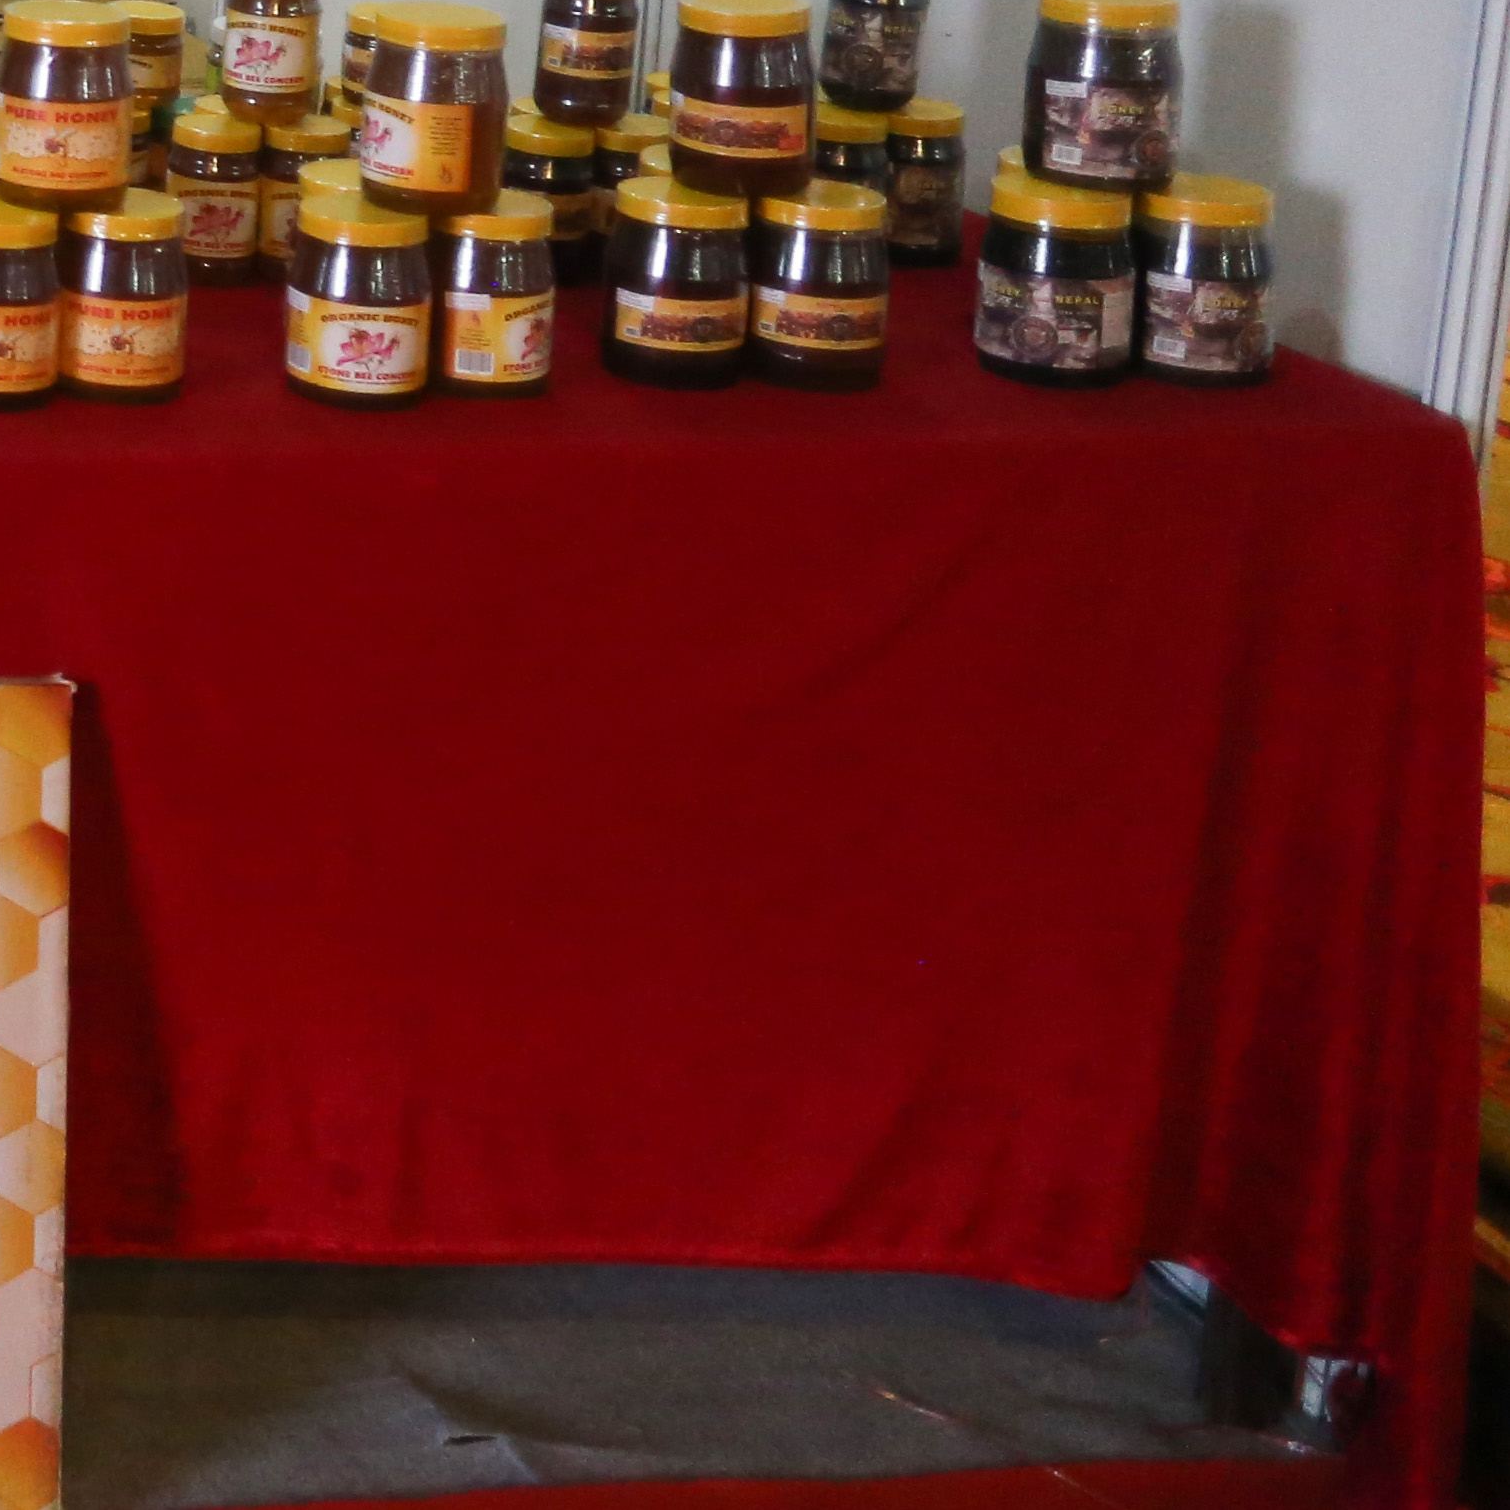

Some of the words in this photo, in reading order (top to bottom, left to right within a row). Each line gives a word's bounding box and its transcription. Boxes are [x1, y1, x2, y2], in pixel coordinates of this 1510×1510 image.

[5, 105, 48, 122] PURE
[55, 108, 119, 123] HONEY
[1056, 296, 1099, 305] NEPAL
[321, 313, 379, 323] ORGANIC
